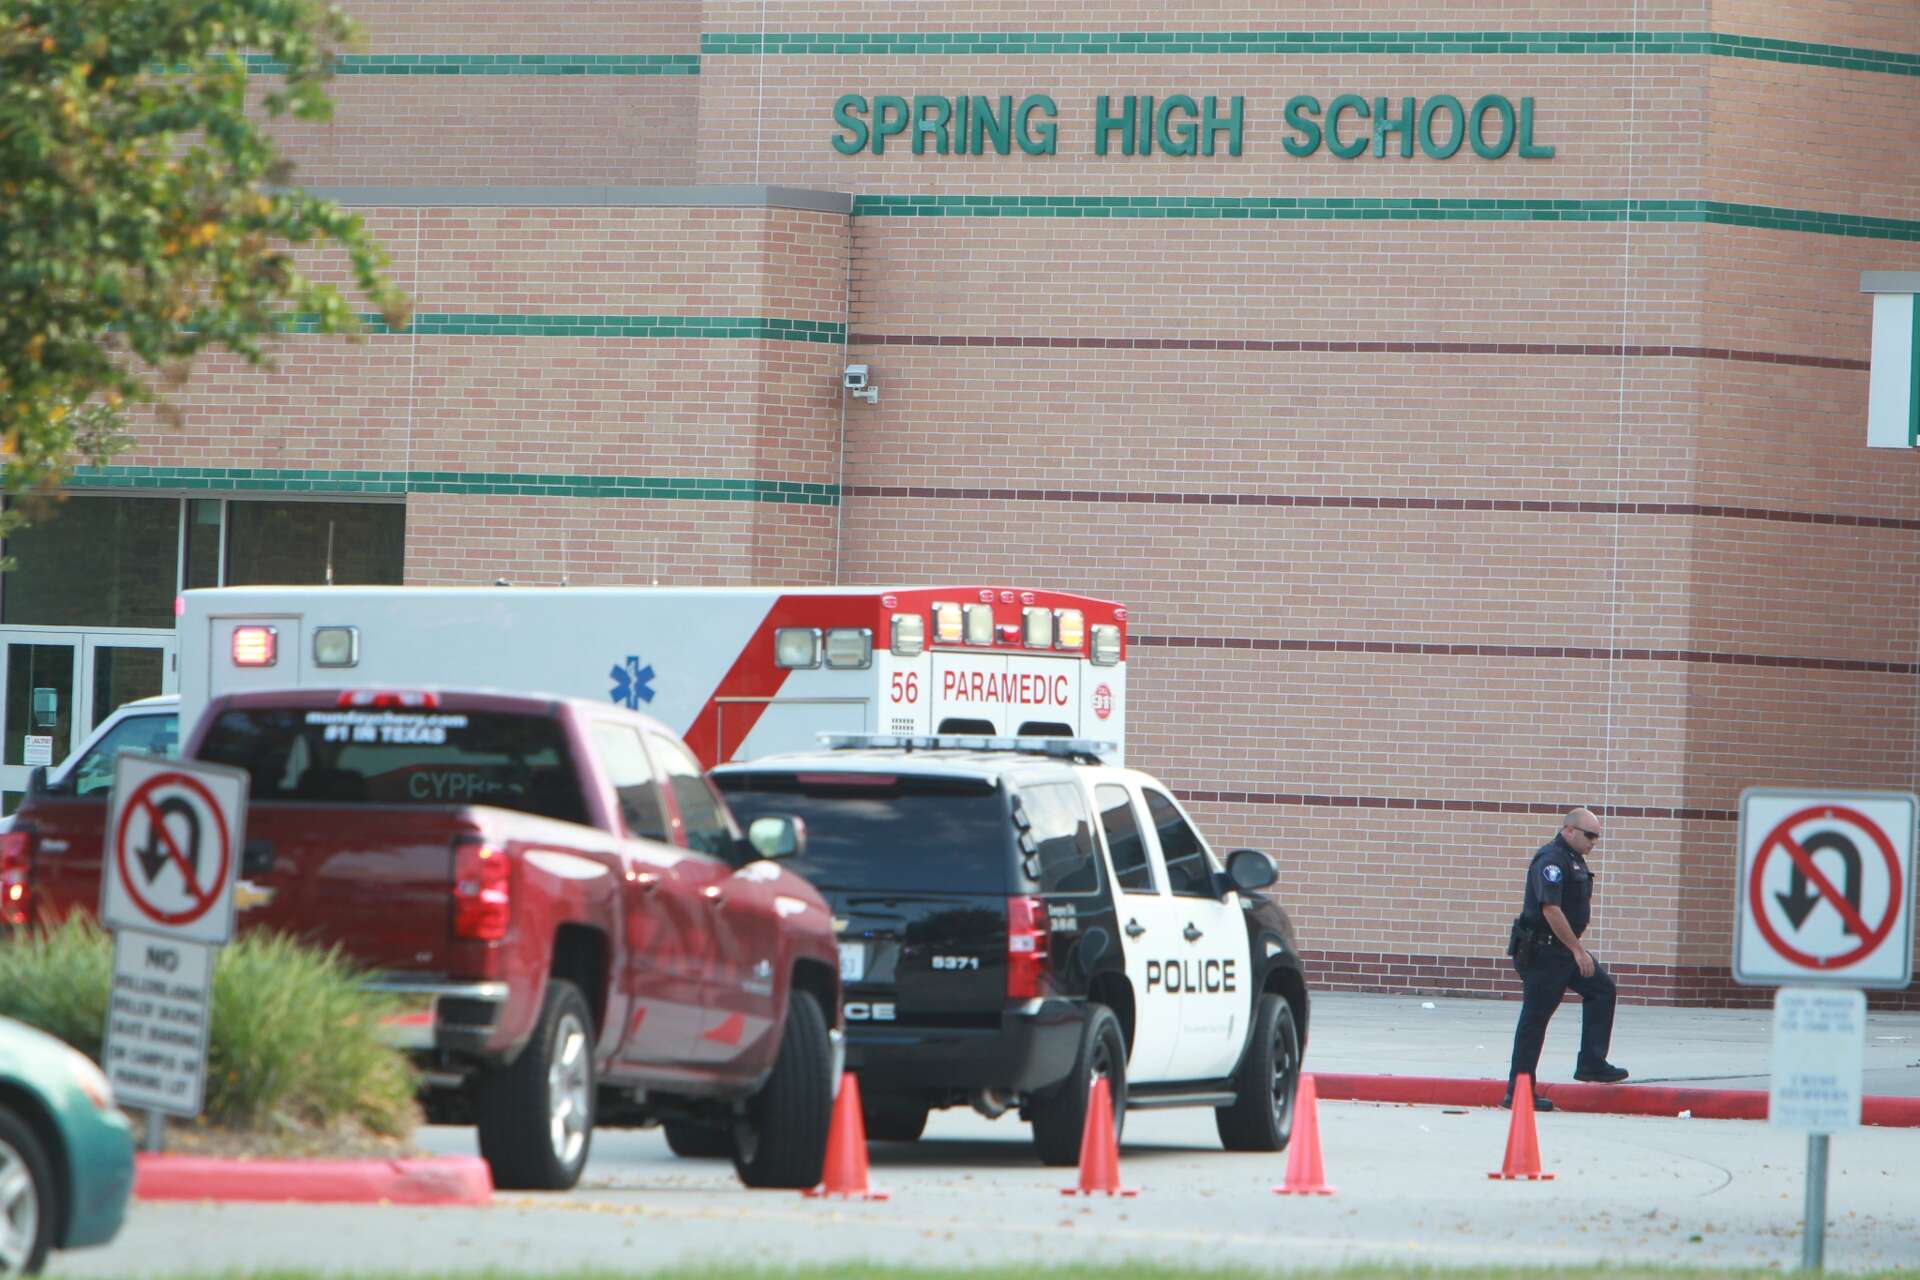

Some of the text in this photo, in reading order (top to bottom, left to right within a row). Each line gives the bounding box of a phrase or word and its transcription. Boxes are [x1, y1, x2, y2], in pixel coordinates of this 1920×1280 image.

[832, 94, 1555, 160] SPRING HIGH SCHOOL
[890, 671, 918, 704] 56
[943, 671, 1068, 706] PARAMEDIC
[324, 725, 447, 744] #1 IN TEXAS
[146, 945, 180, 973] NO
[1146, 959, 1236, 994] POLICE
[843, 1002, 897, 1021] CE
